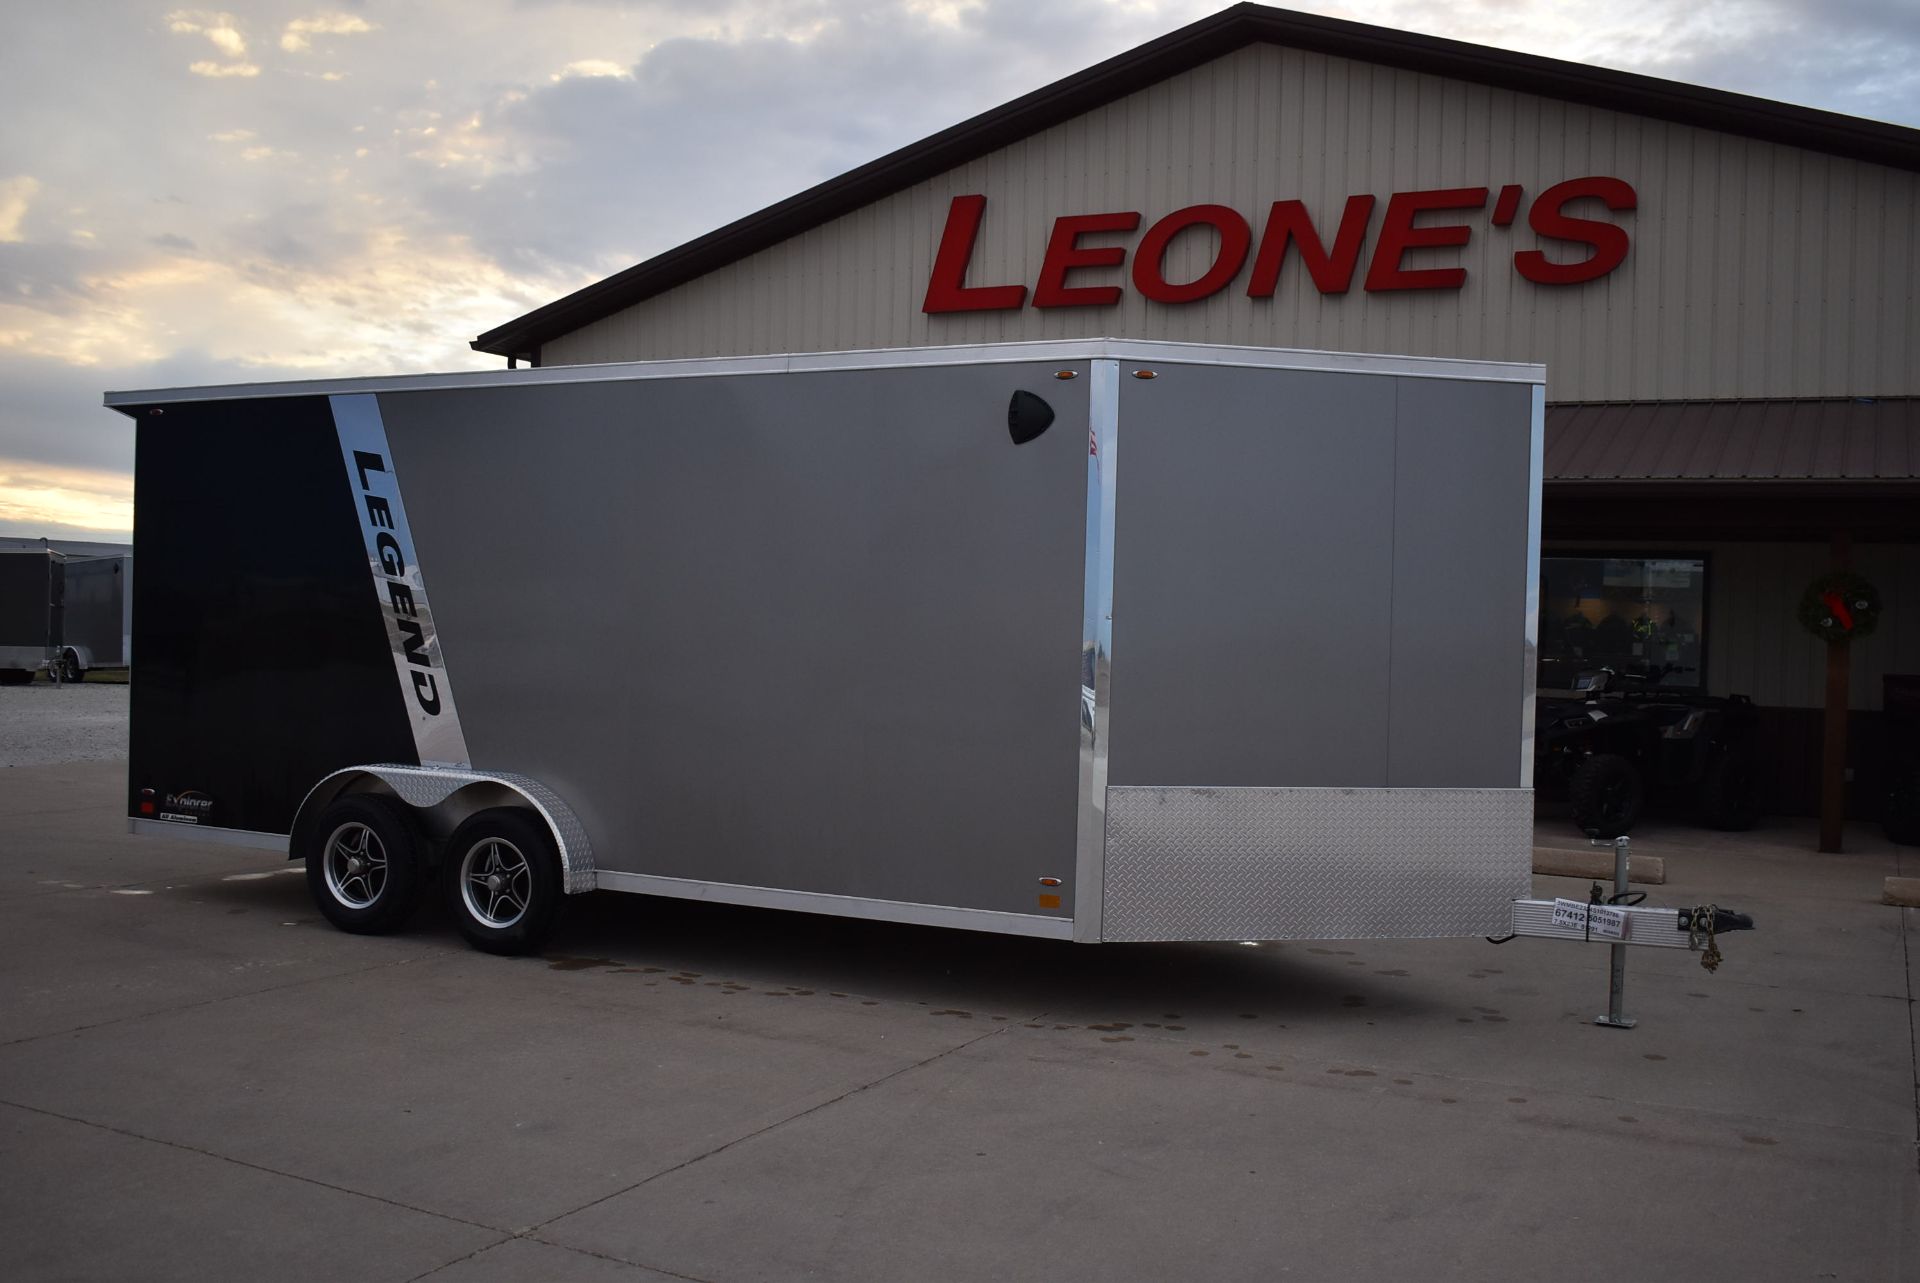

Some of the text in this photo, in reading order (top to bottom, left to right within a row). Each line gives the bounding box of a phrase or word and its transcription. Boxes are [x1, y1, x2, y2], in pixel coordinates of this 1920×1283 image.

[922, 176, 1638, 314] LEONE'S
[352, 450, 442, 717] LEGEND
[1555, 908, 1585, 922] 67412
